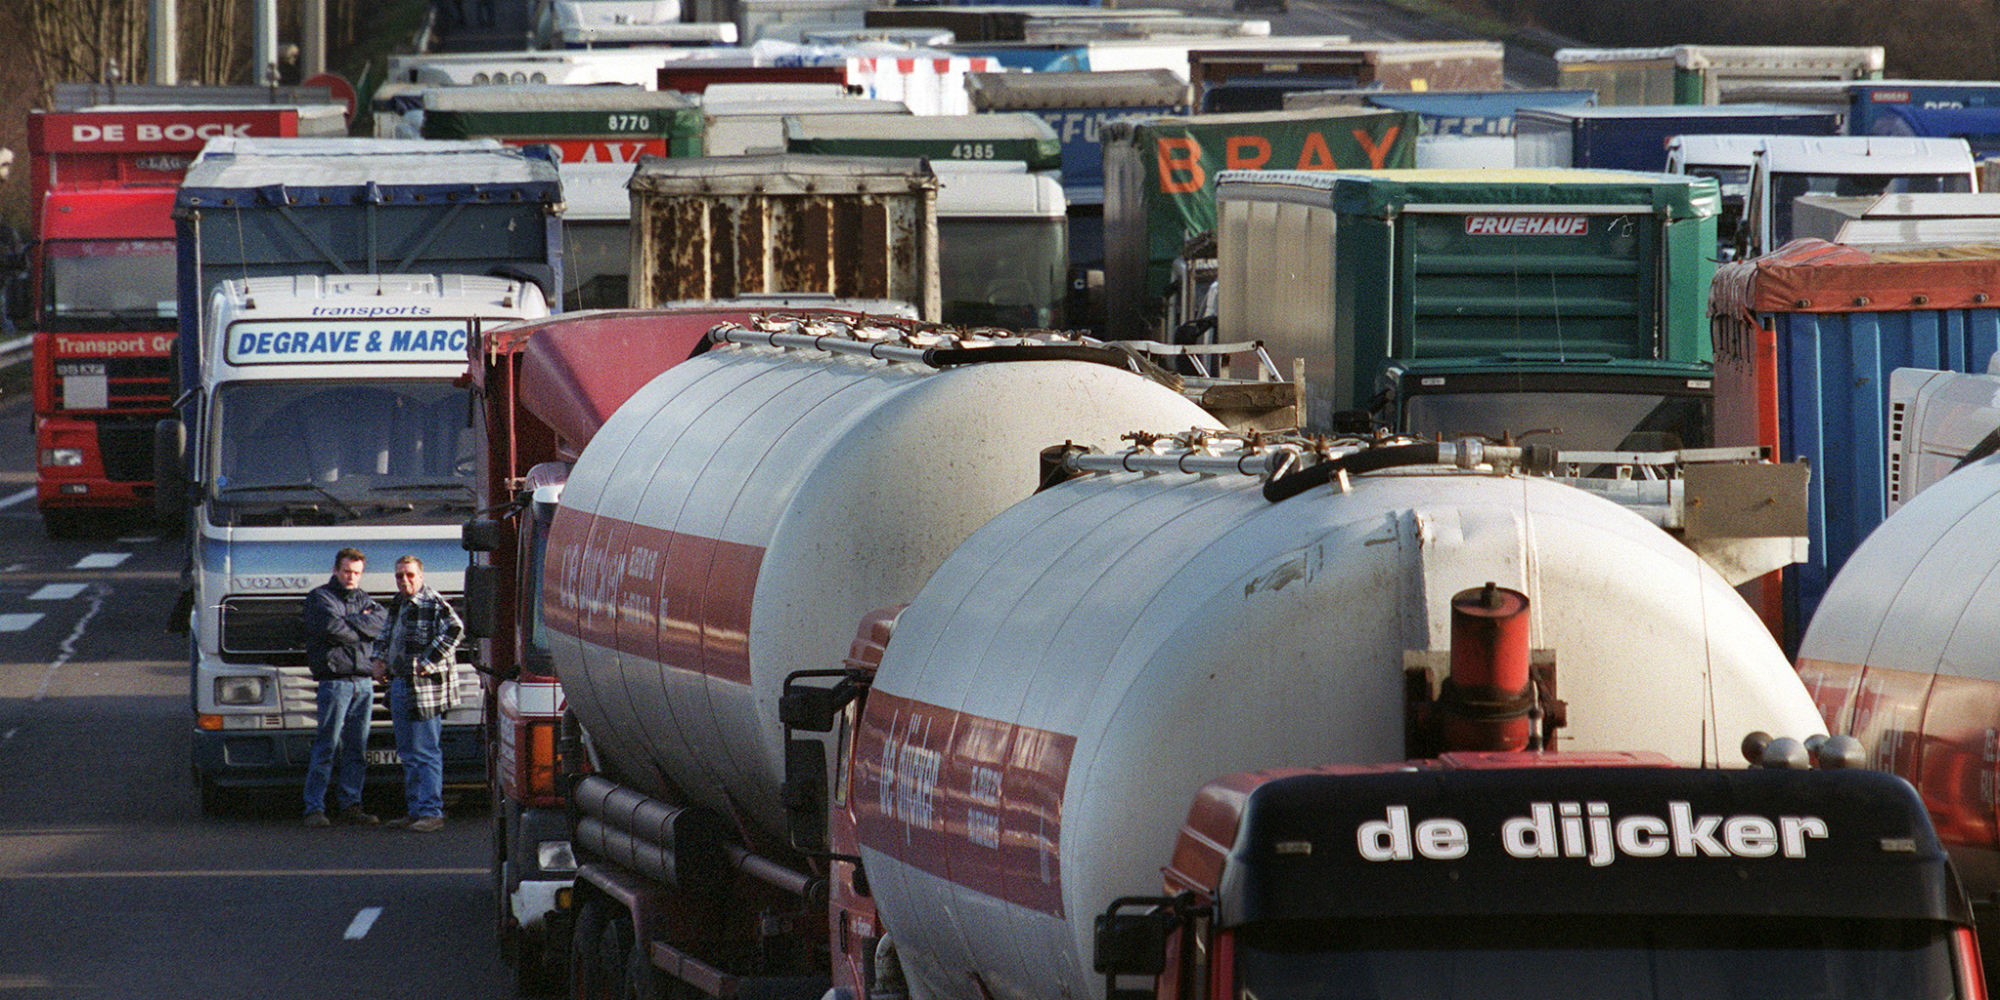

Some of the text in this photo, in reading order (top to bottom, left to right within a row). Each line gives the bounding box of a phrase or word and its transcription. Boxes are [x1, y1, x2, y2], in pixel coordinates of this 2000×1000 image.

[608, 114, 650, 131] 8770
[72, 123, 252, 142] DE BOCK
[951, 143, 995, 159] 4385
[1157, 126, 1400, 194] BRAY
[1467, 216, 1587, 234] FRUEHAUF
[311, 305, 432, 317] transports
[56, 337, 145, 355] Transport
[237, 329, 468, 355] DEGRAVE & MARC
[880, 708, 941, 846] de dijcker
[1357, 801, 1829, 866] de dijcker
